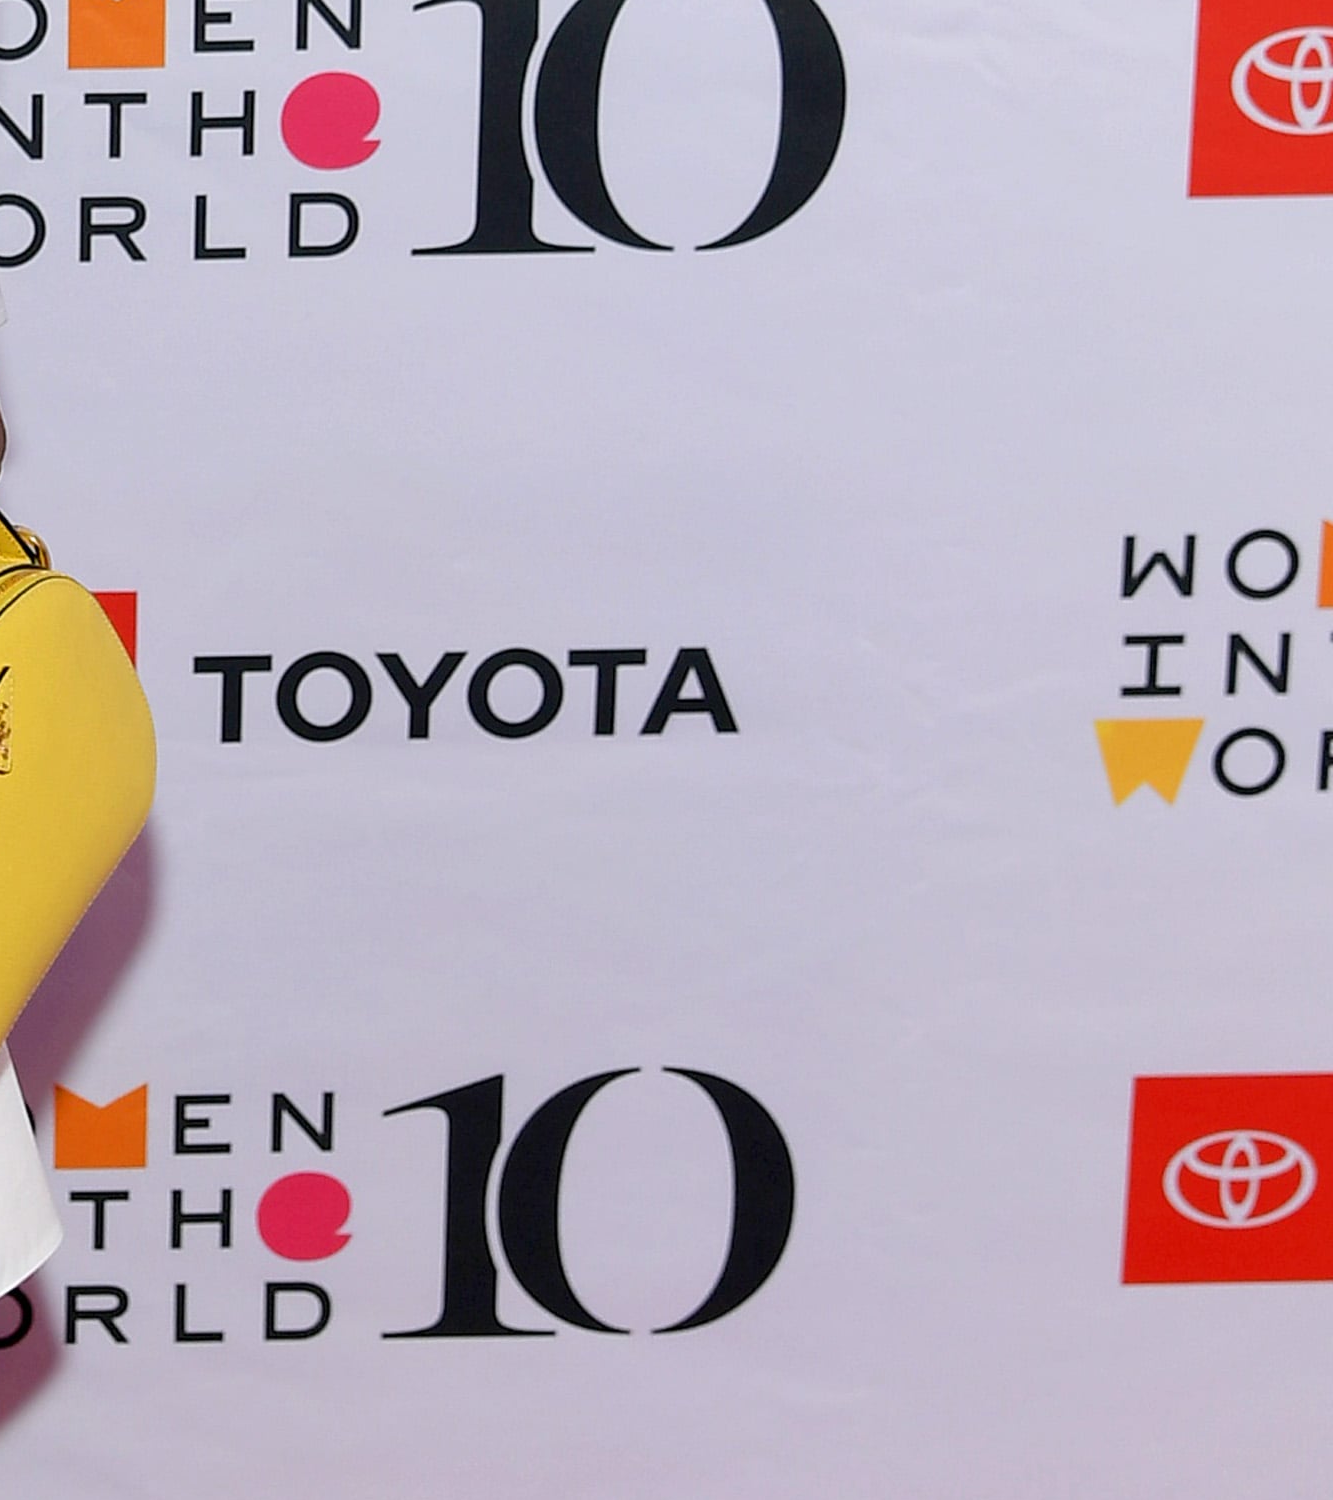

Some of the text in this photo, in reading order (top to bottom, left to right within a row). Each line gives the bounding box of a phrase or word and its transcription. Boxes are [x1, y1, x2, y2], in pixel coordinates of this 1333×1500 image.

[1121, 519, 1333, 609] WO
[193, 647, 739, 744] TOYOTA
[1121, 632, 1333, 697] IN
[1094, 718, 1333, 806] WO
[381, 1066, 796, 1340] 10
